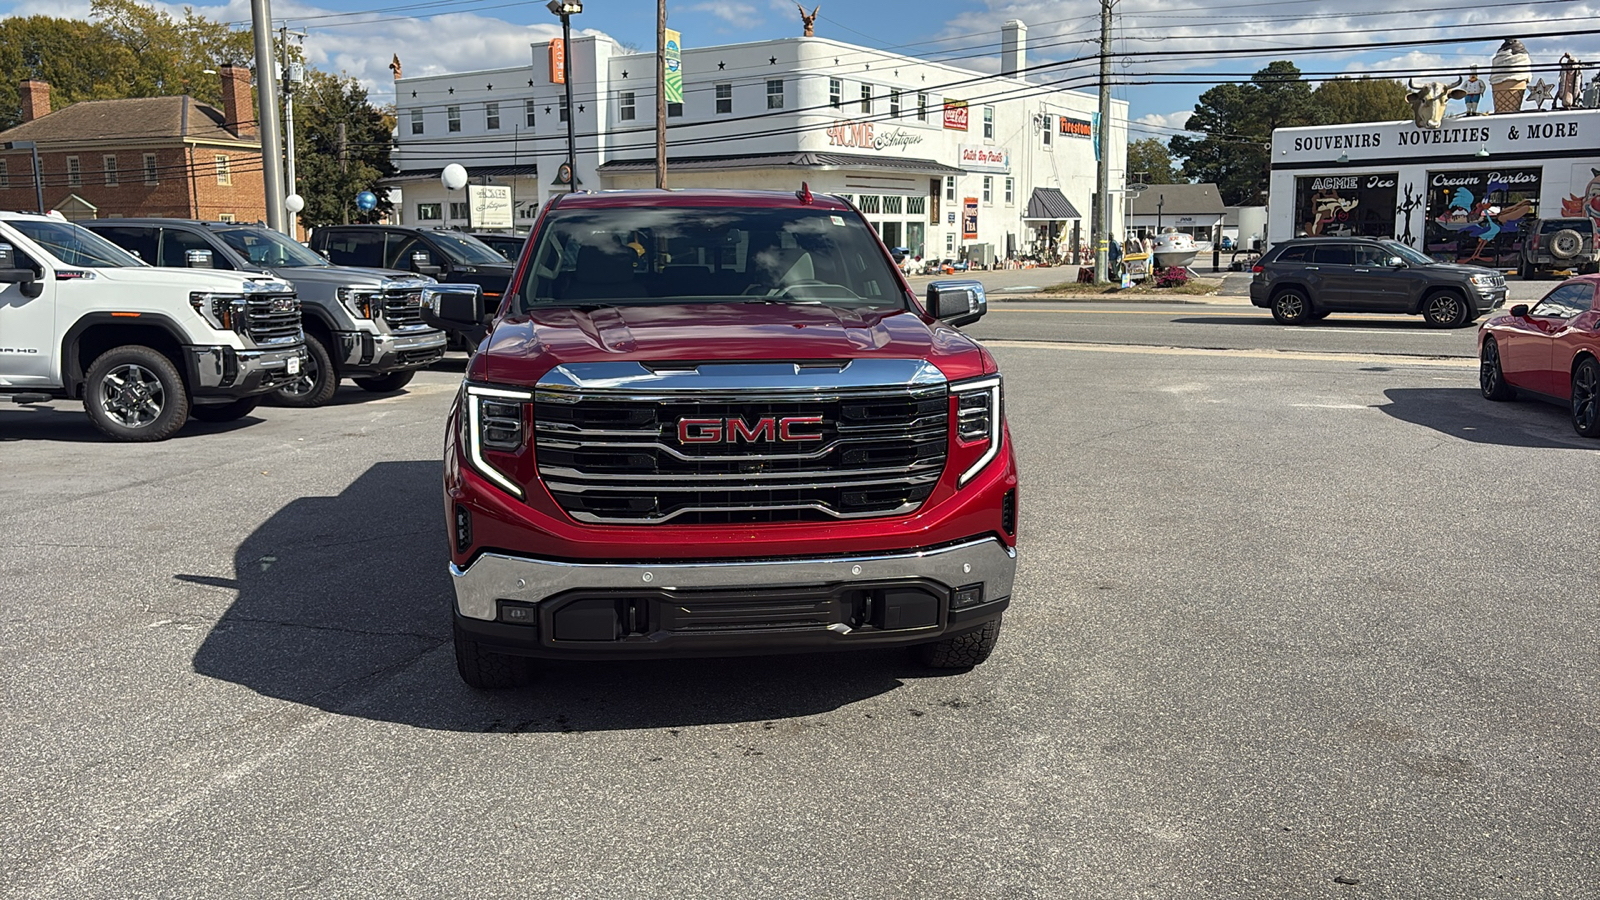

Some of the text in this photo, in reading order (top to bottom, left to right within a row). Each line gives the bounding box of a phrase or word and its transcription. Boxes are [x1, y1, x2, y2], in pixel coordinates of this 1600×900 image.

[826, 118, 875, 149] ACME
[1294, 122, 1578, 151] SOUVENIRS NOVELTIES & MORE
[1311, 175, 1395, 190] ACME Ice
[1432, 171, 1539, 186] Cream Parlor
[677, 416, 824, 444] GMC
